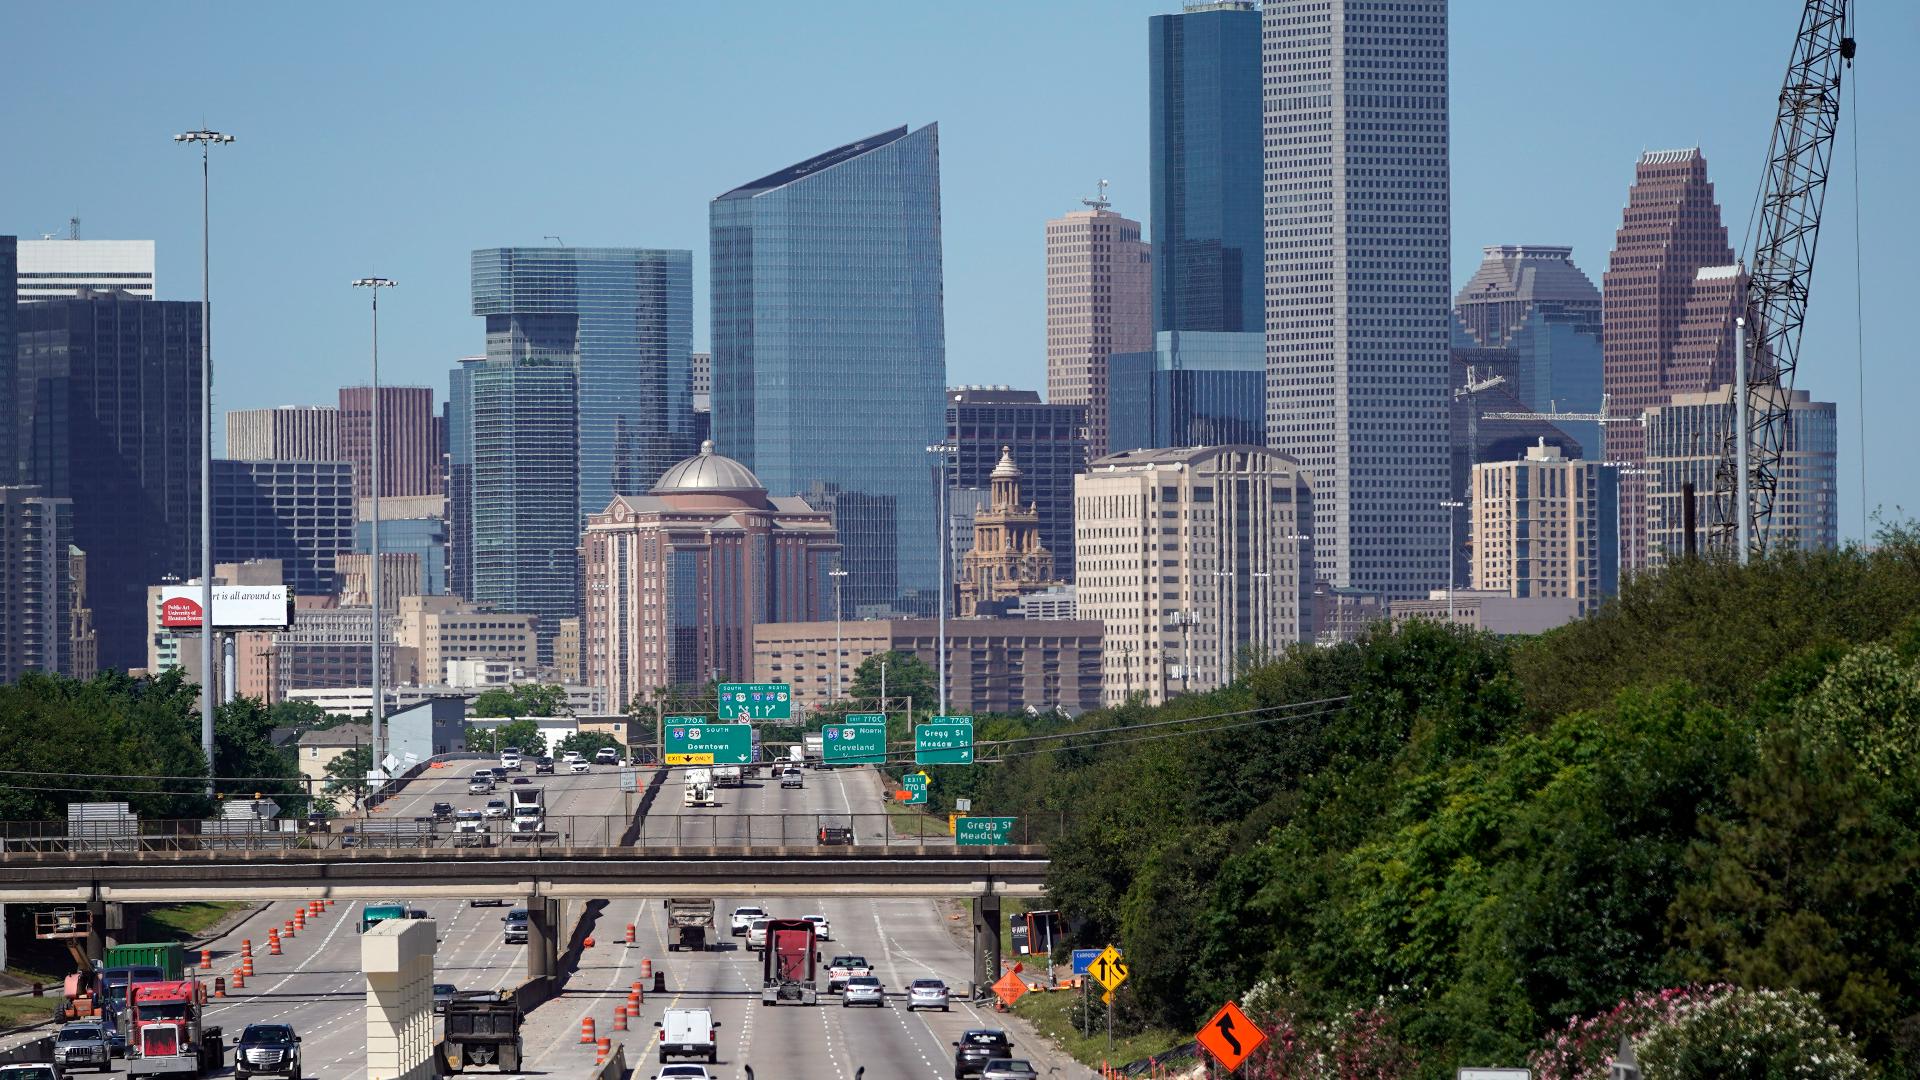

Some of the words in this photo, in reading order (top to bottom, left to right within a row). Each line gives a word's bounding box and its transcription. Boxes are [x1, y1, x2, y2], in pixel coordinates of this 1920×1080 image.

[222, 591, 228, 600] is
[230, 591, 240, 600] all
[241, 591, 270, 600] around
[924, 730, 948, 738] Gregg
[834, 744, 875, 752] Cleveland
[967, 822, 998, 830] Gregg
[1002, 821, 1012, 830] St
[960, 832, 1002, 840] Meadow
